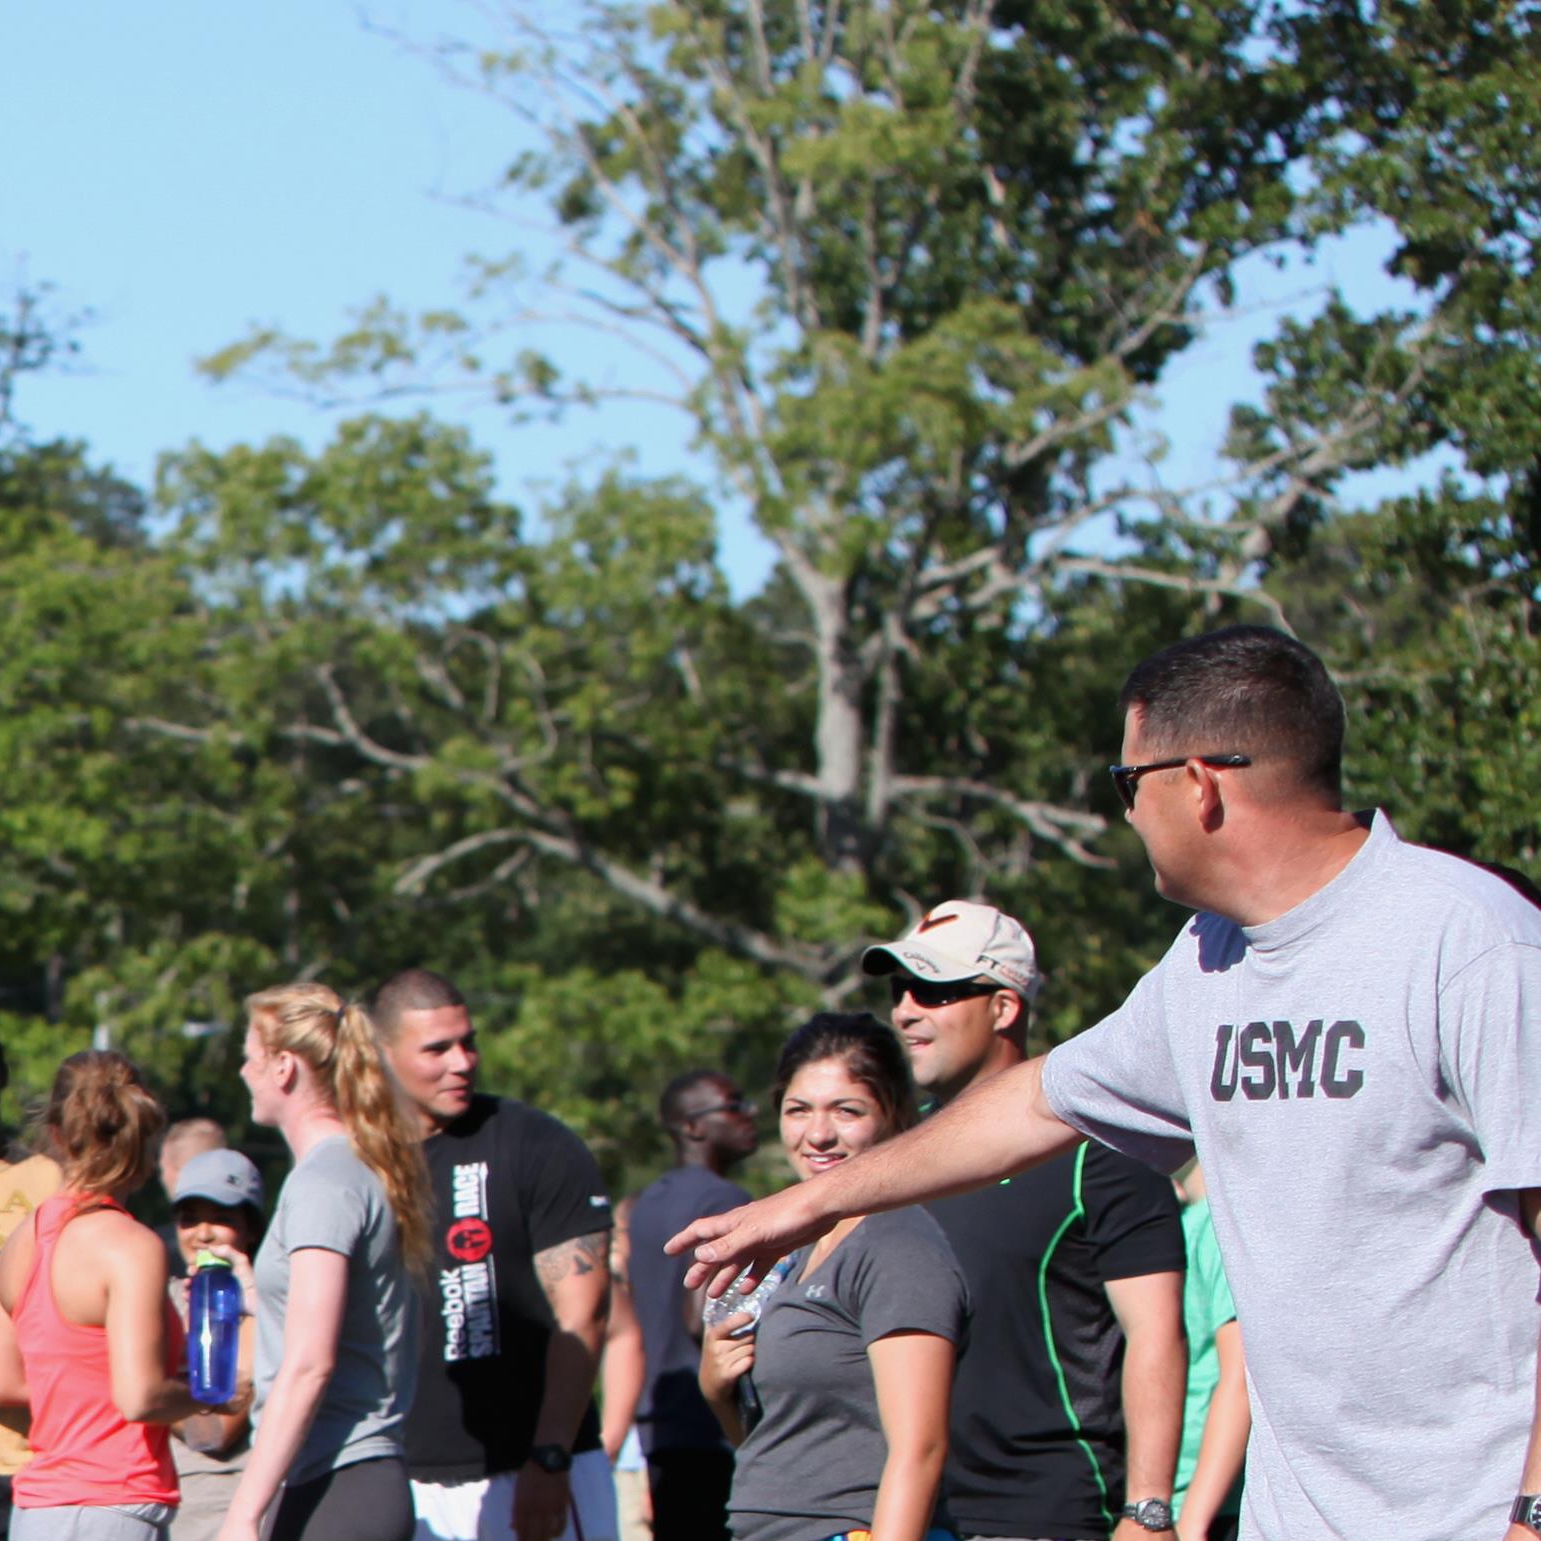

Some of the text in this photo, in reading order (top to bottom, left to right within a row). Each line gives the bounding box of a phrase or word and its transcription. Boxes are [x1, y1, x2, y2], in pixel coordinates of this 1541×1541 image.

[1210, 1019, 1366, 1102] USMC
[453, 1162, 481, 1218] RACE
[439, 1266, 467, 1363] Reebok
[461, 1261, 494, 1359] SPARTAN
